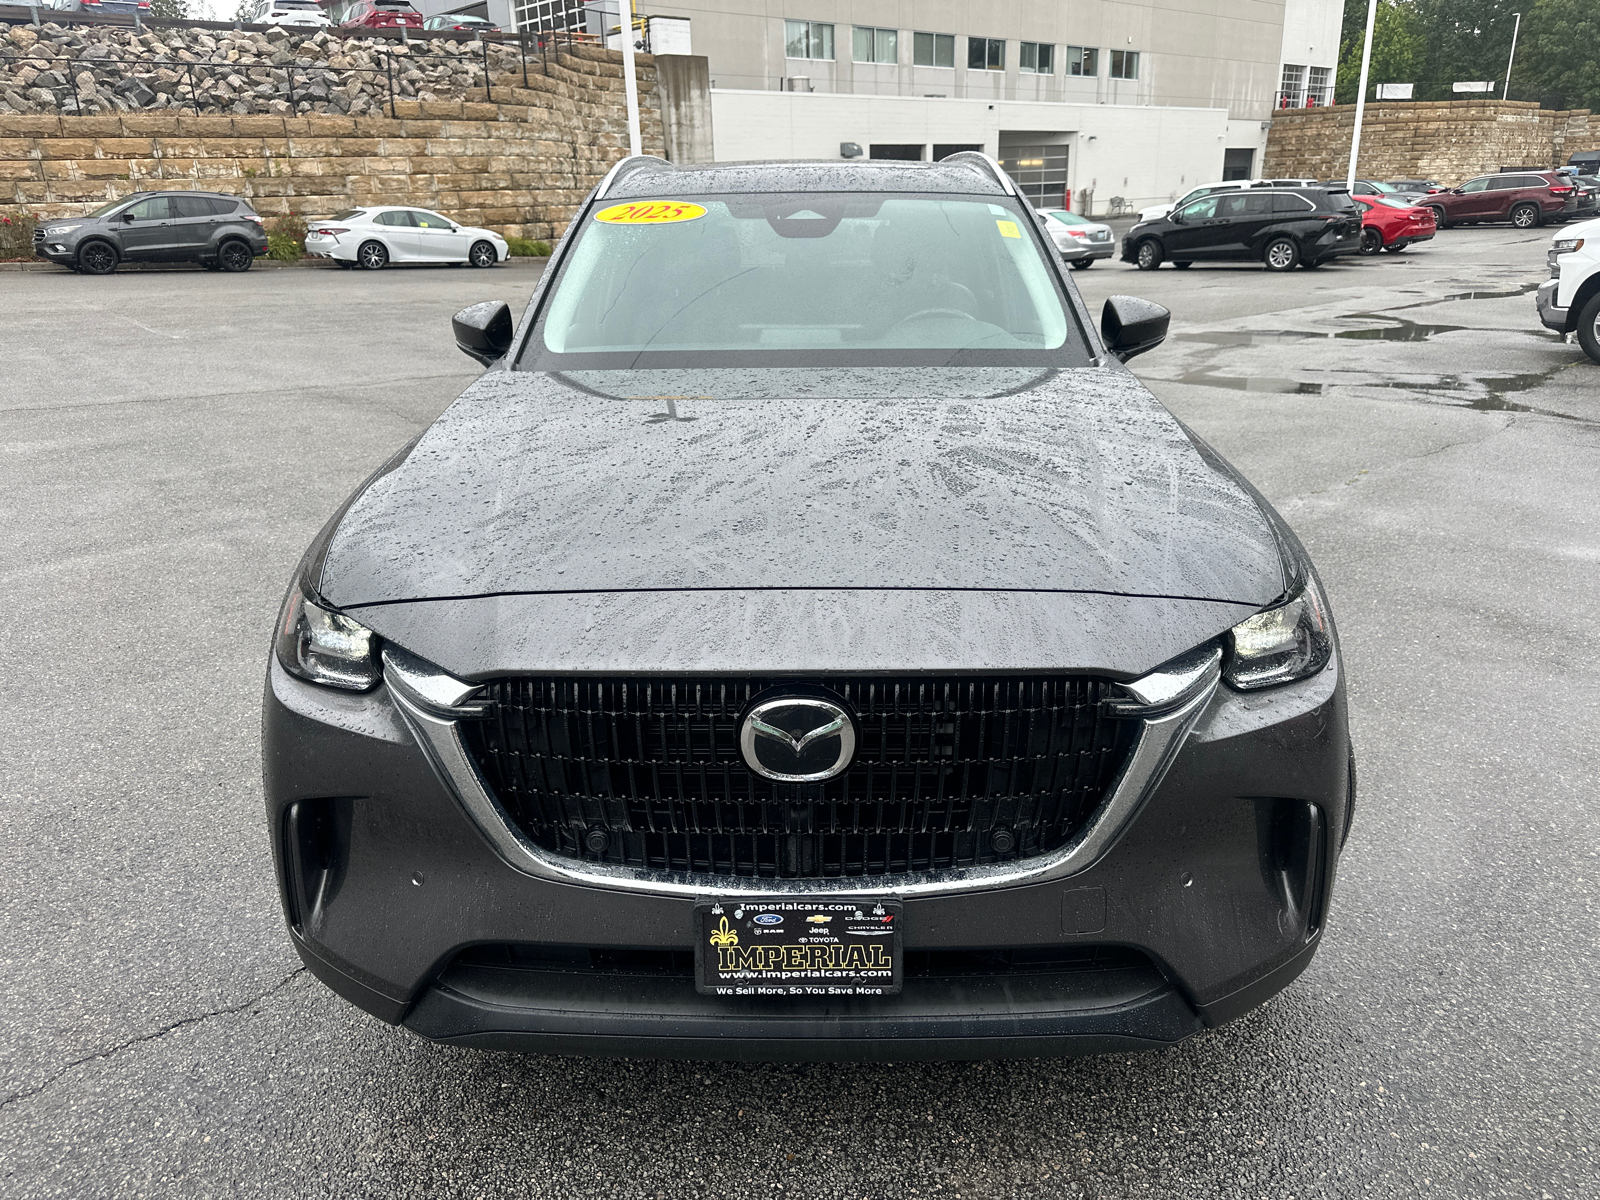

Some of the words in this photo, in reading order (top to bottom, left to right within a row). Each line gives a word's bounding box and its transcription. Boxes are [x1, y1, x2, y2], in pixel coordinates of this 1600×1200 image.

[610, 205, 691, 220] 2025
[740, 902, 857, 912] Imperialcars.com
[808, 927, 829, 935] Jeep
[718, 945, 892, 970] IMPERIAL
[719, 970, 892, 979] www.imperialcars.com
[716, 987, 733, 995] We
[735, 987, 754, 995] Sell
[758, 987, 787, 996] More,
[789, 987, 803, 995] So
[805, 987, 825, 995] You
[828, 987, 853, 995] Save
[856, 987, 882, 995] More
